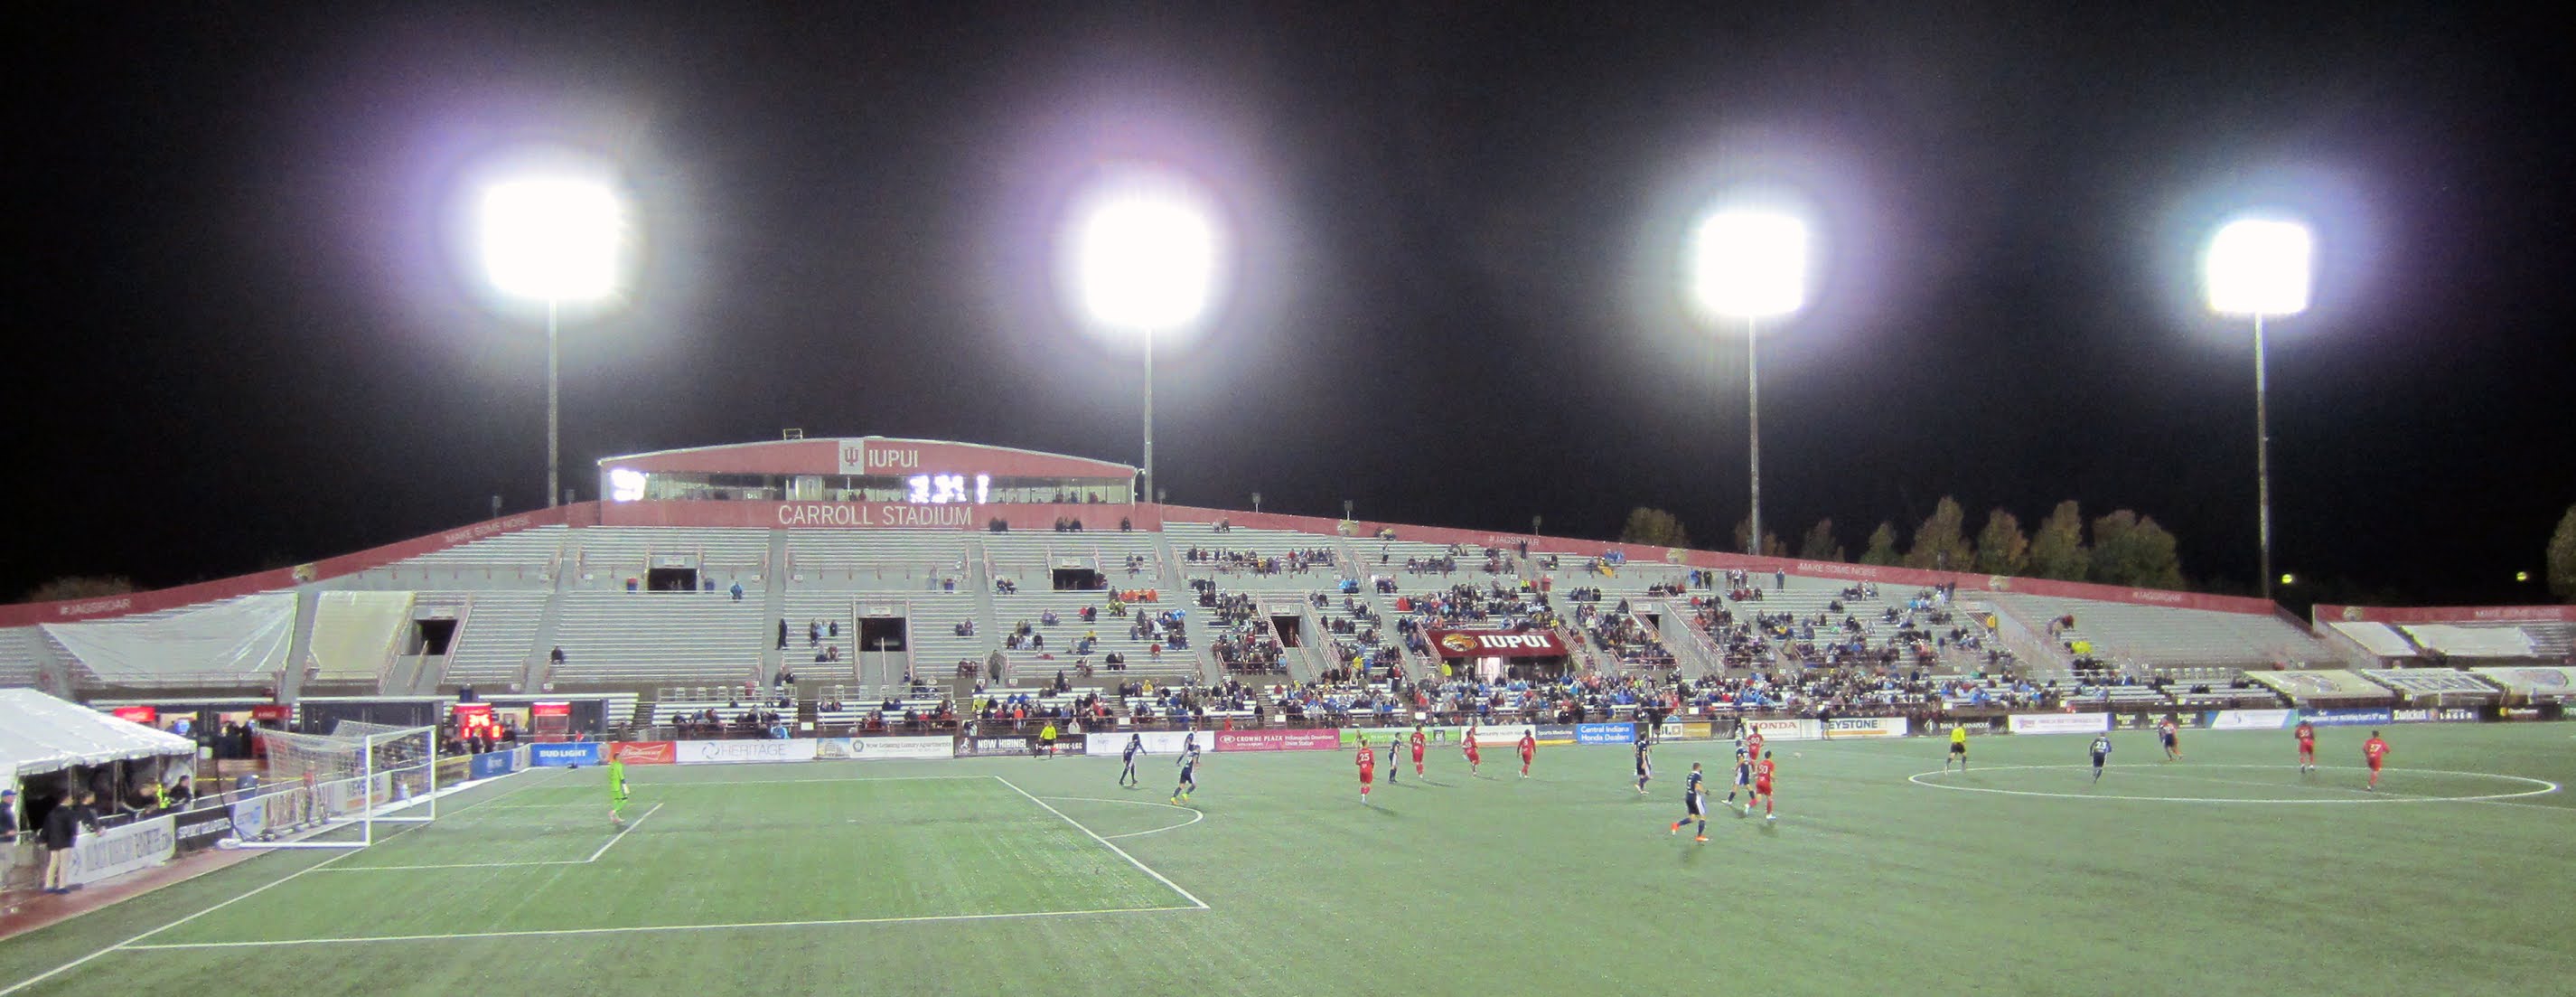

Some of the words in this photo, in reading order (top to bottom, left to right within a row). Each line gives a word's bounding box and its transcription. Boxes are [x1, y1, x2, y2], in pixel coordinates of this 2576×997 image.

[868, 449, 918, 468] IUPUI
[778, 505, 874, 525] CARROLL
[883, 506, 972, 525] STADIUM
[1798, 562, 1823, 573] MAKE
[1826, 565, 1850, 575] SOME
[1851, 567, 1877, 577] NOISE
[1478, 635, 1551, 648] IUPUI
[1580, 725, 1605, 733] Central
[1606, 725, 1629, 733] Indiana
[1749, 721, 1797, 729] HONDA
[1822, 720, 1878, 729] EYSTONE
[978, 739, 998, 749] NOW
[998, 738, 1027, 748] HIRING!
[2095, 741, 2107, 749] 23
[539, 749, 559, 757] BUD
[560, 749, 587, 757] LIGHT
[722, 743, 786, 757] HERITAGE
[1359, 753, 1371, 762] 25
